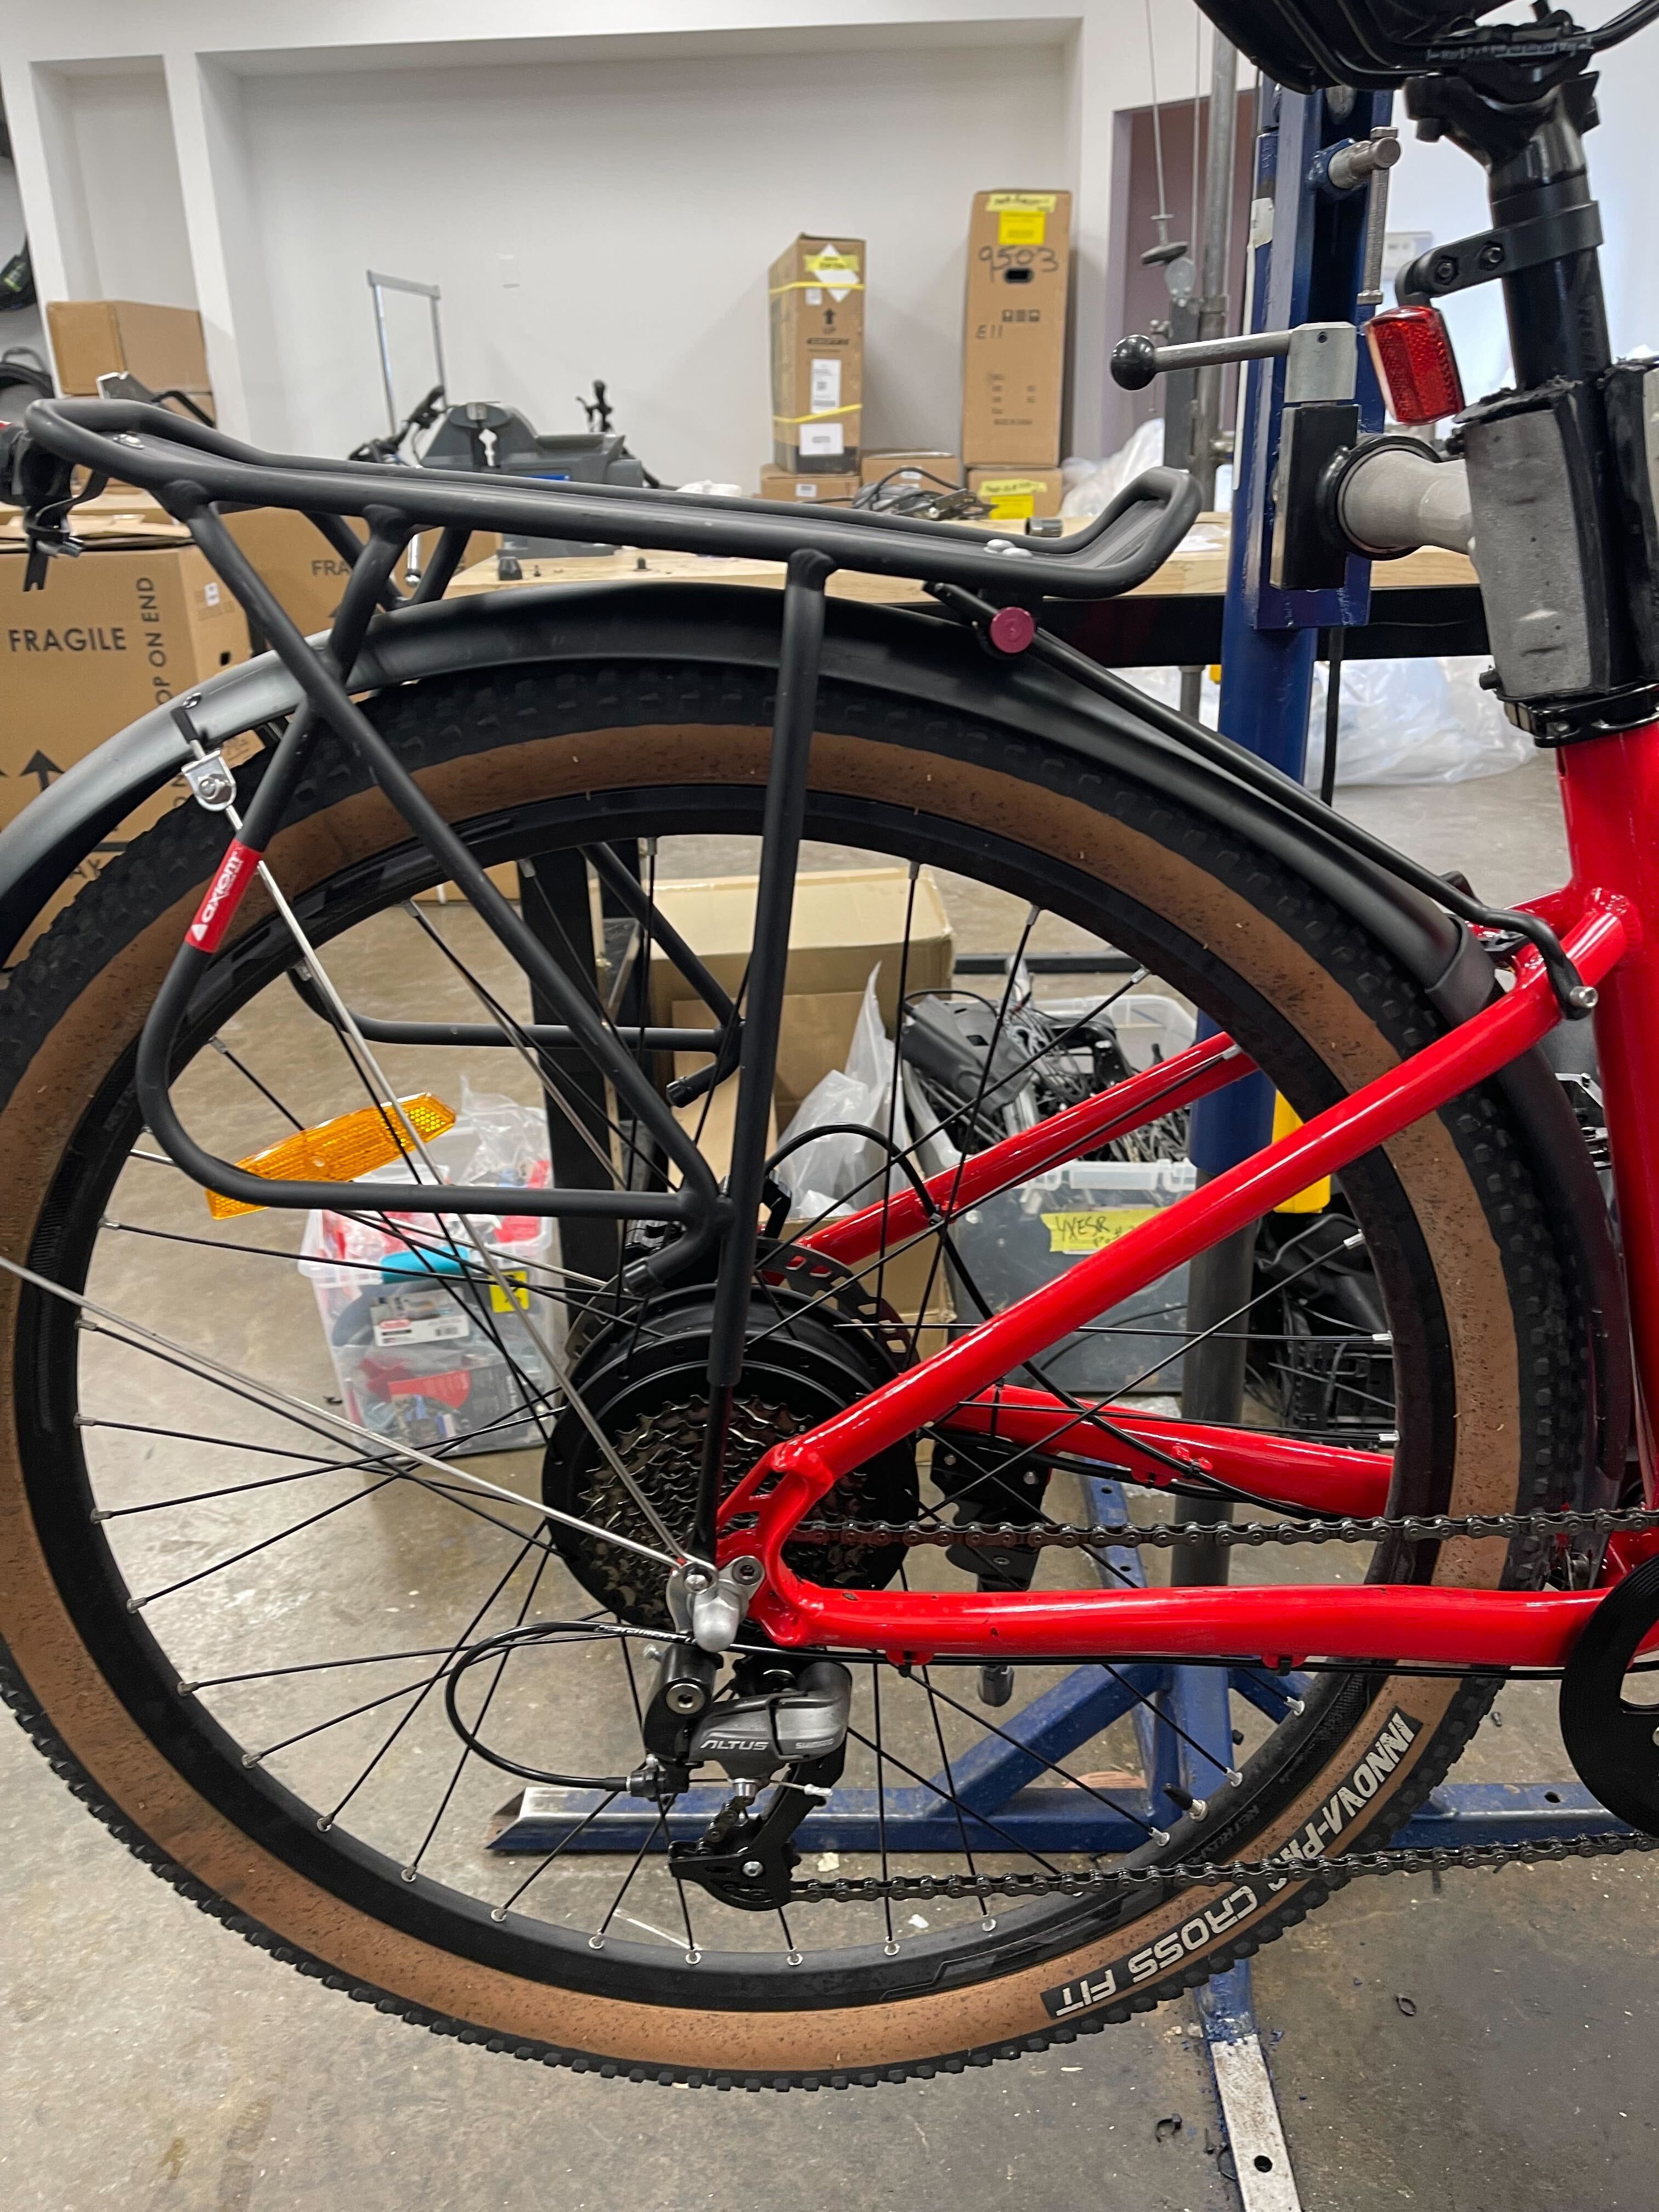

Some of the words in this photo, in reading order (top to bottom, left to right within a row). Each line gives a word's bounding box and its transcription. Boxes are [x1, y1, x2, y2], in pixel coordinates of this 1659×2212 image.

[979, 245, 1059, 282] 9503
[136, 577, 160, 622] END
[8, 627, 127, 652] FRAGILE
[144, 631, 167, 668] ON
[152, 675, 173, 704] OP
[700, 1740, 769, 1751] ALTUS
[1128, 1886, 1258, 1983] CROSS
[1056, 1969, 1116, 2016] FIT
